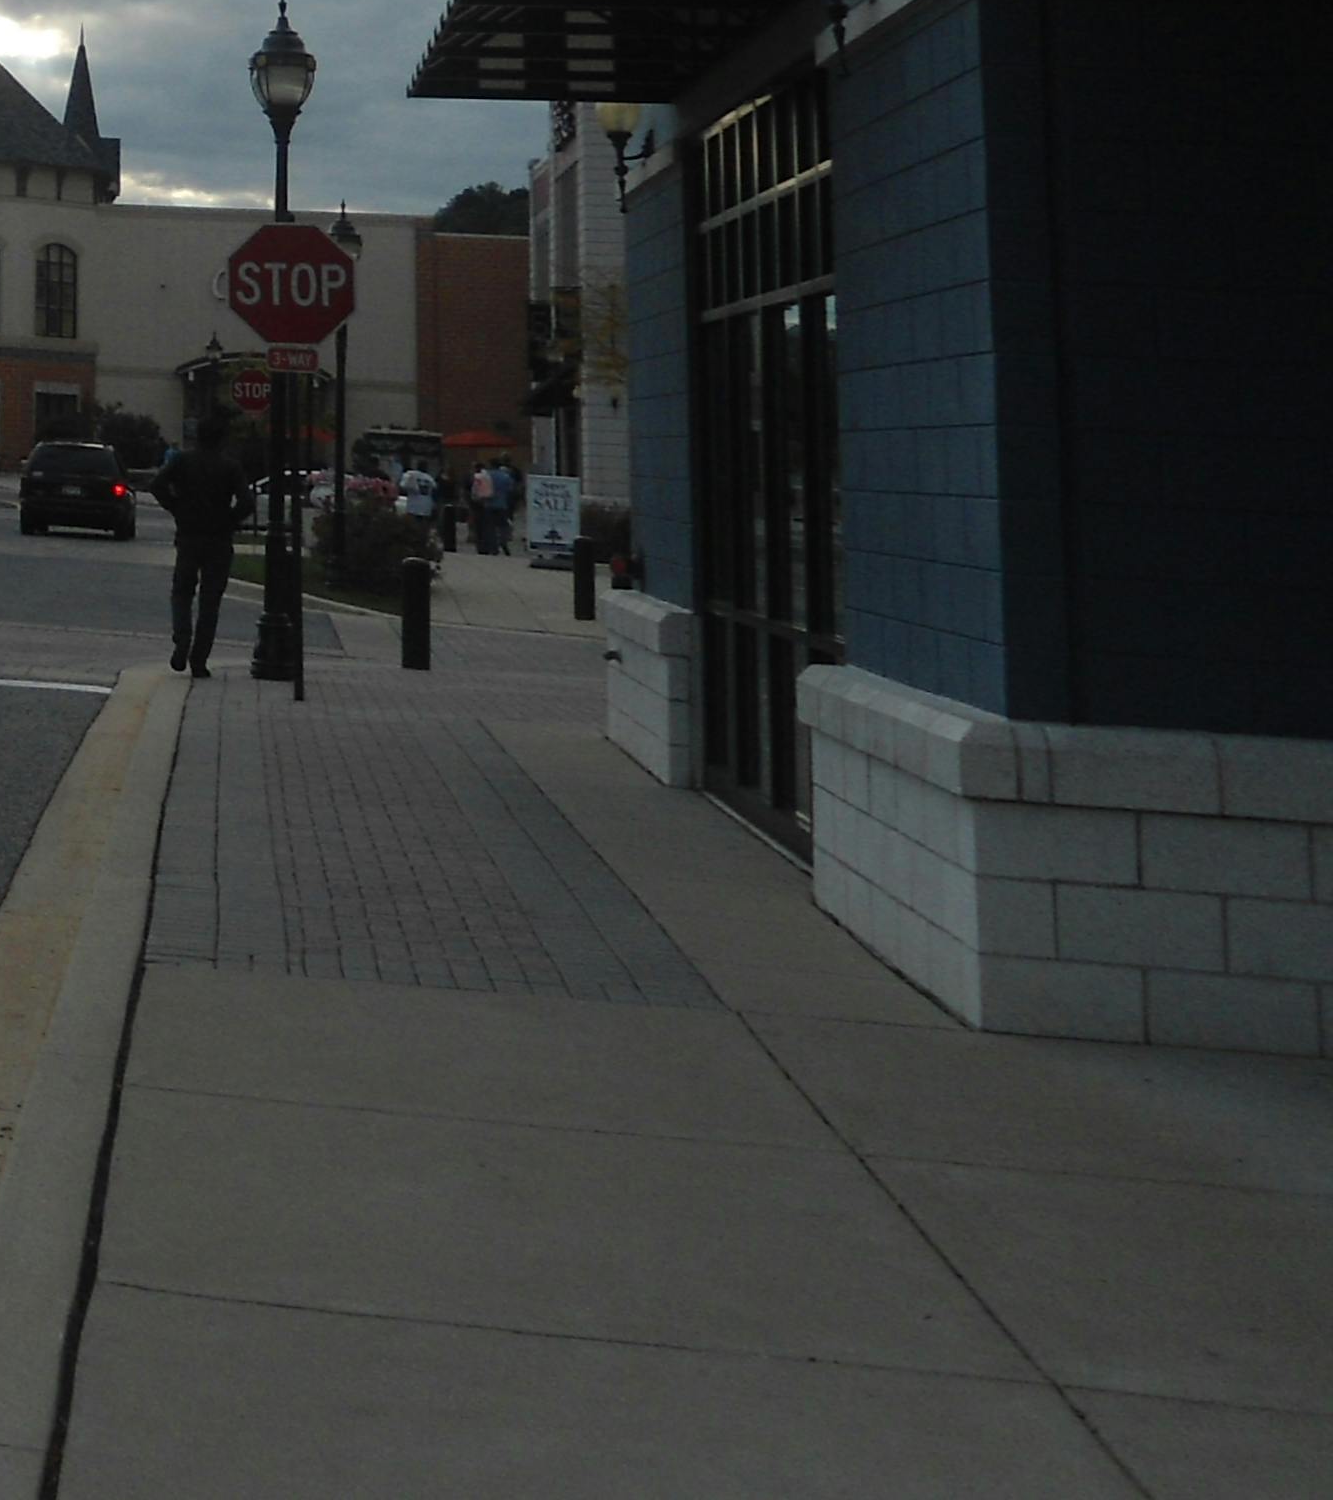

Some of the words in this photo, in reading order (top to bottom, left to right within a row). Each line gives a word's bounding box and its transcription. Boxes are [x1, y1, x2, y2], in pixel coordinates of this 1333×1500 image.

[236, 261, 347, 308] STOP
[272, 352, 312, 367] 3-WAY
[234, 382, 272, 399] STOP
[533, 498, 574, 512] SALE
